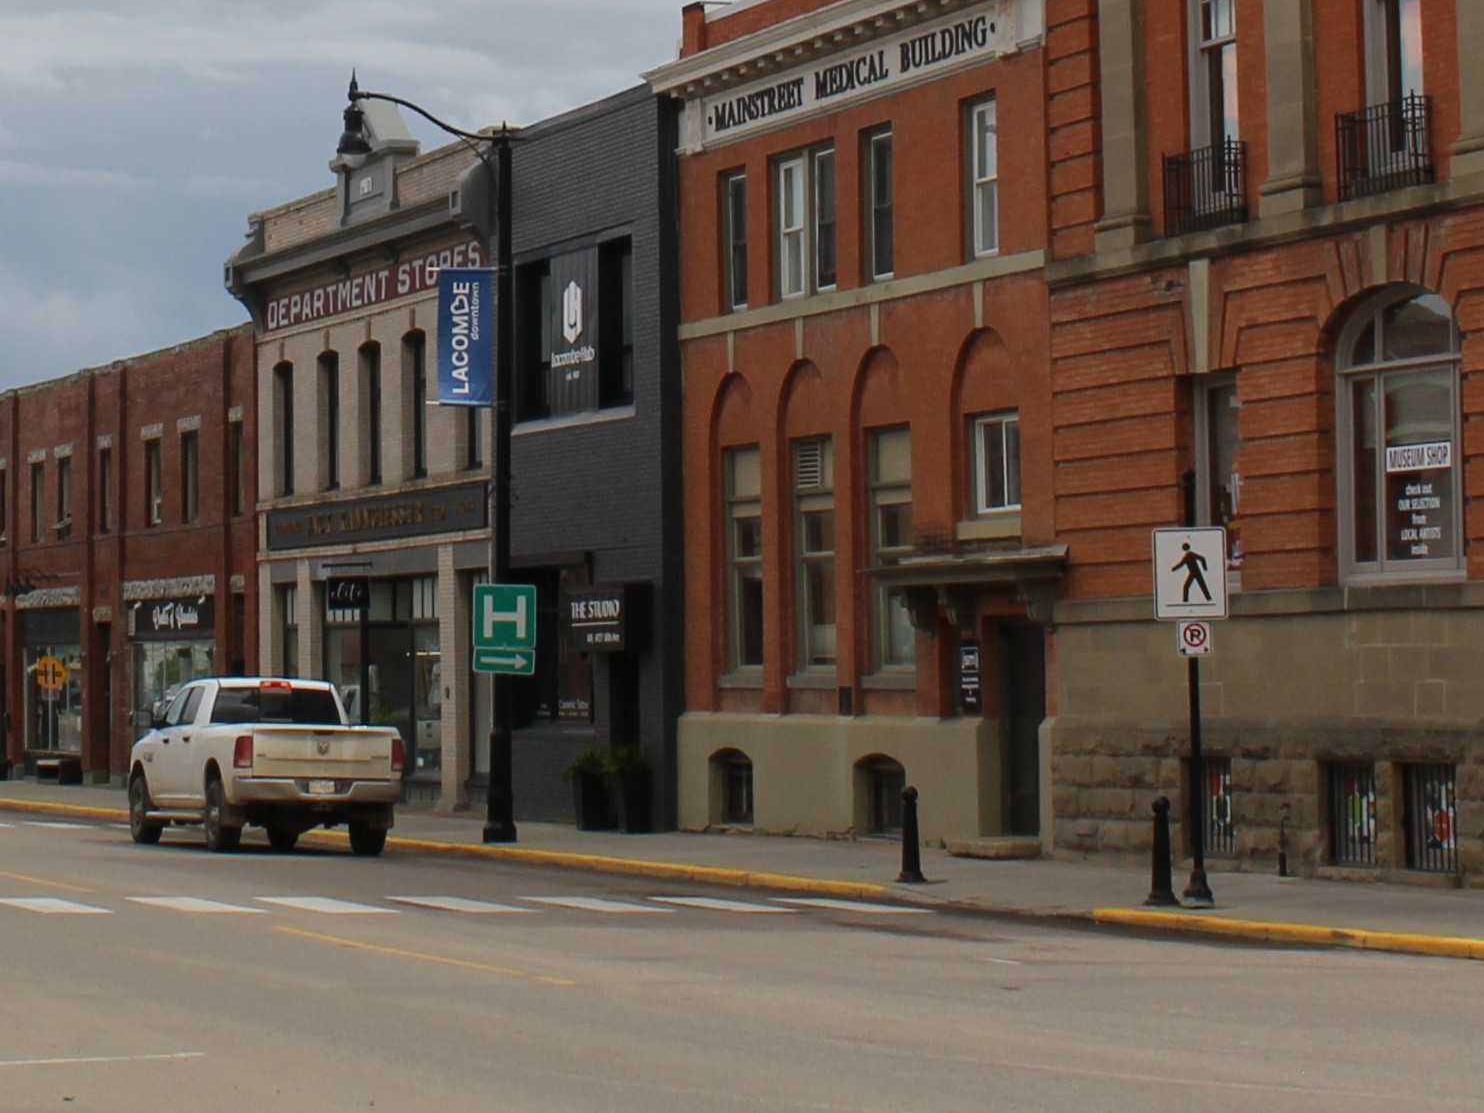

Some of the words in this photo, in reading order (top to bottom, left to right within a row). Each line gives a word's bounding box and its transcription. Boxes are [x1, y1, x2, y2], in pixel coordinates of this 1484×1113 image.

[714, 77, 804, 132] MAINSTREET
[814, 50, 889, 100] MEDICAL
[899, 16, 988, 74] BUILDING
[268, 270, 390, 330] DEPARTMENT
[470, 282, 480, 341] downtown
[1389, 448, 1425, 469] MUSEUM
[1427, 445, 1448, 466] SHOP
[1401, 528, 1419, 541] LOCAL
[330, 581, 364, 601] elite
[483, 595, 526, 639] H
[570, 601, 587, 619] THE
[588, 599, 620, 618] STUDIO
